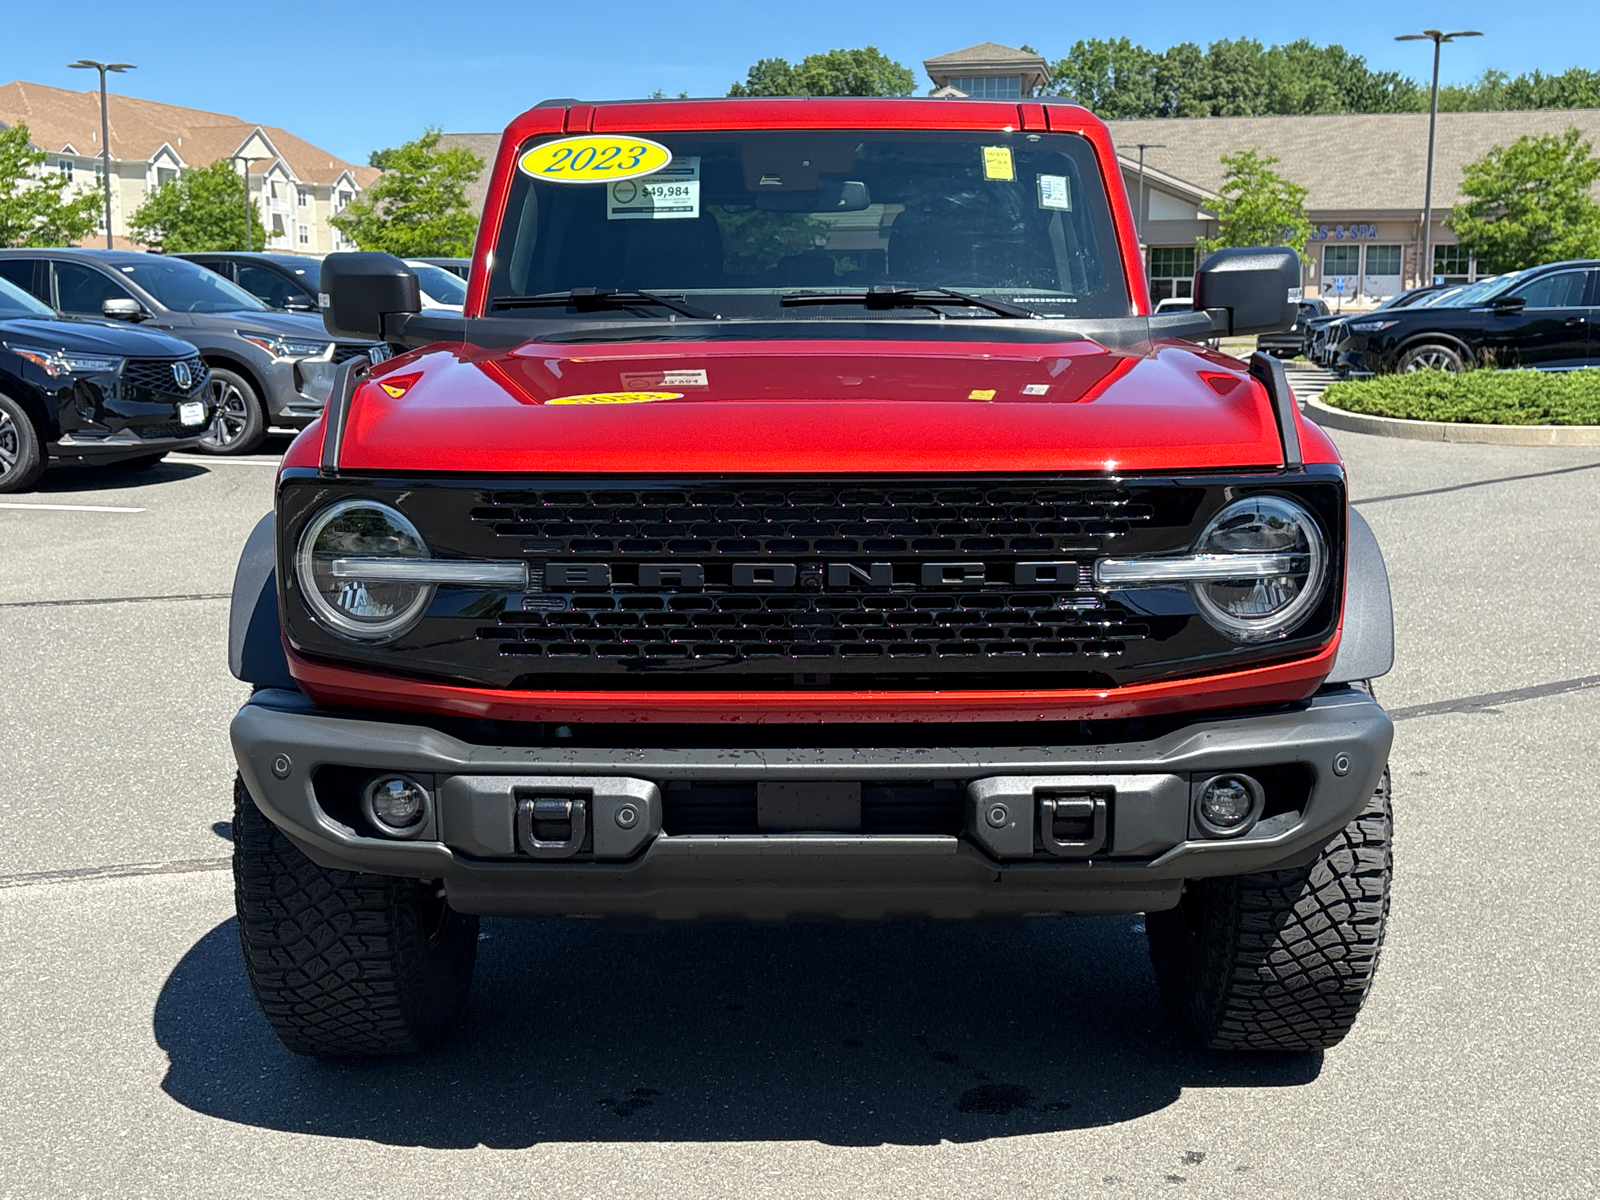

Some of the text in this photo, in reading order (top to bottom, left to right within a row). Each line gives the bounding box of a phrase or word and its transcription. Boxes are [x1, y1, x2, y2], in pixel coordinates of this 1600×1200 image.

[542, 146, 648, 173] 2023
[641, 186, 690, 198] $49,984
[1335, 224, 1345, 240] &
[1349, 224, 1377, 240] SPA
[545, 561, 1078, 587] BRONCO
